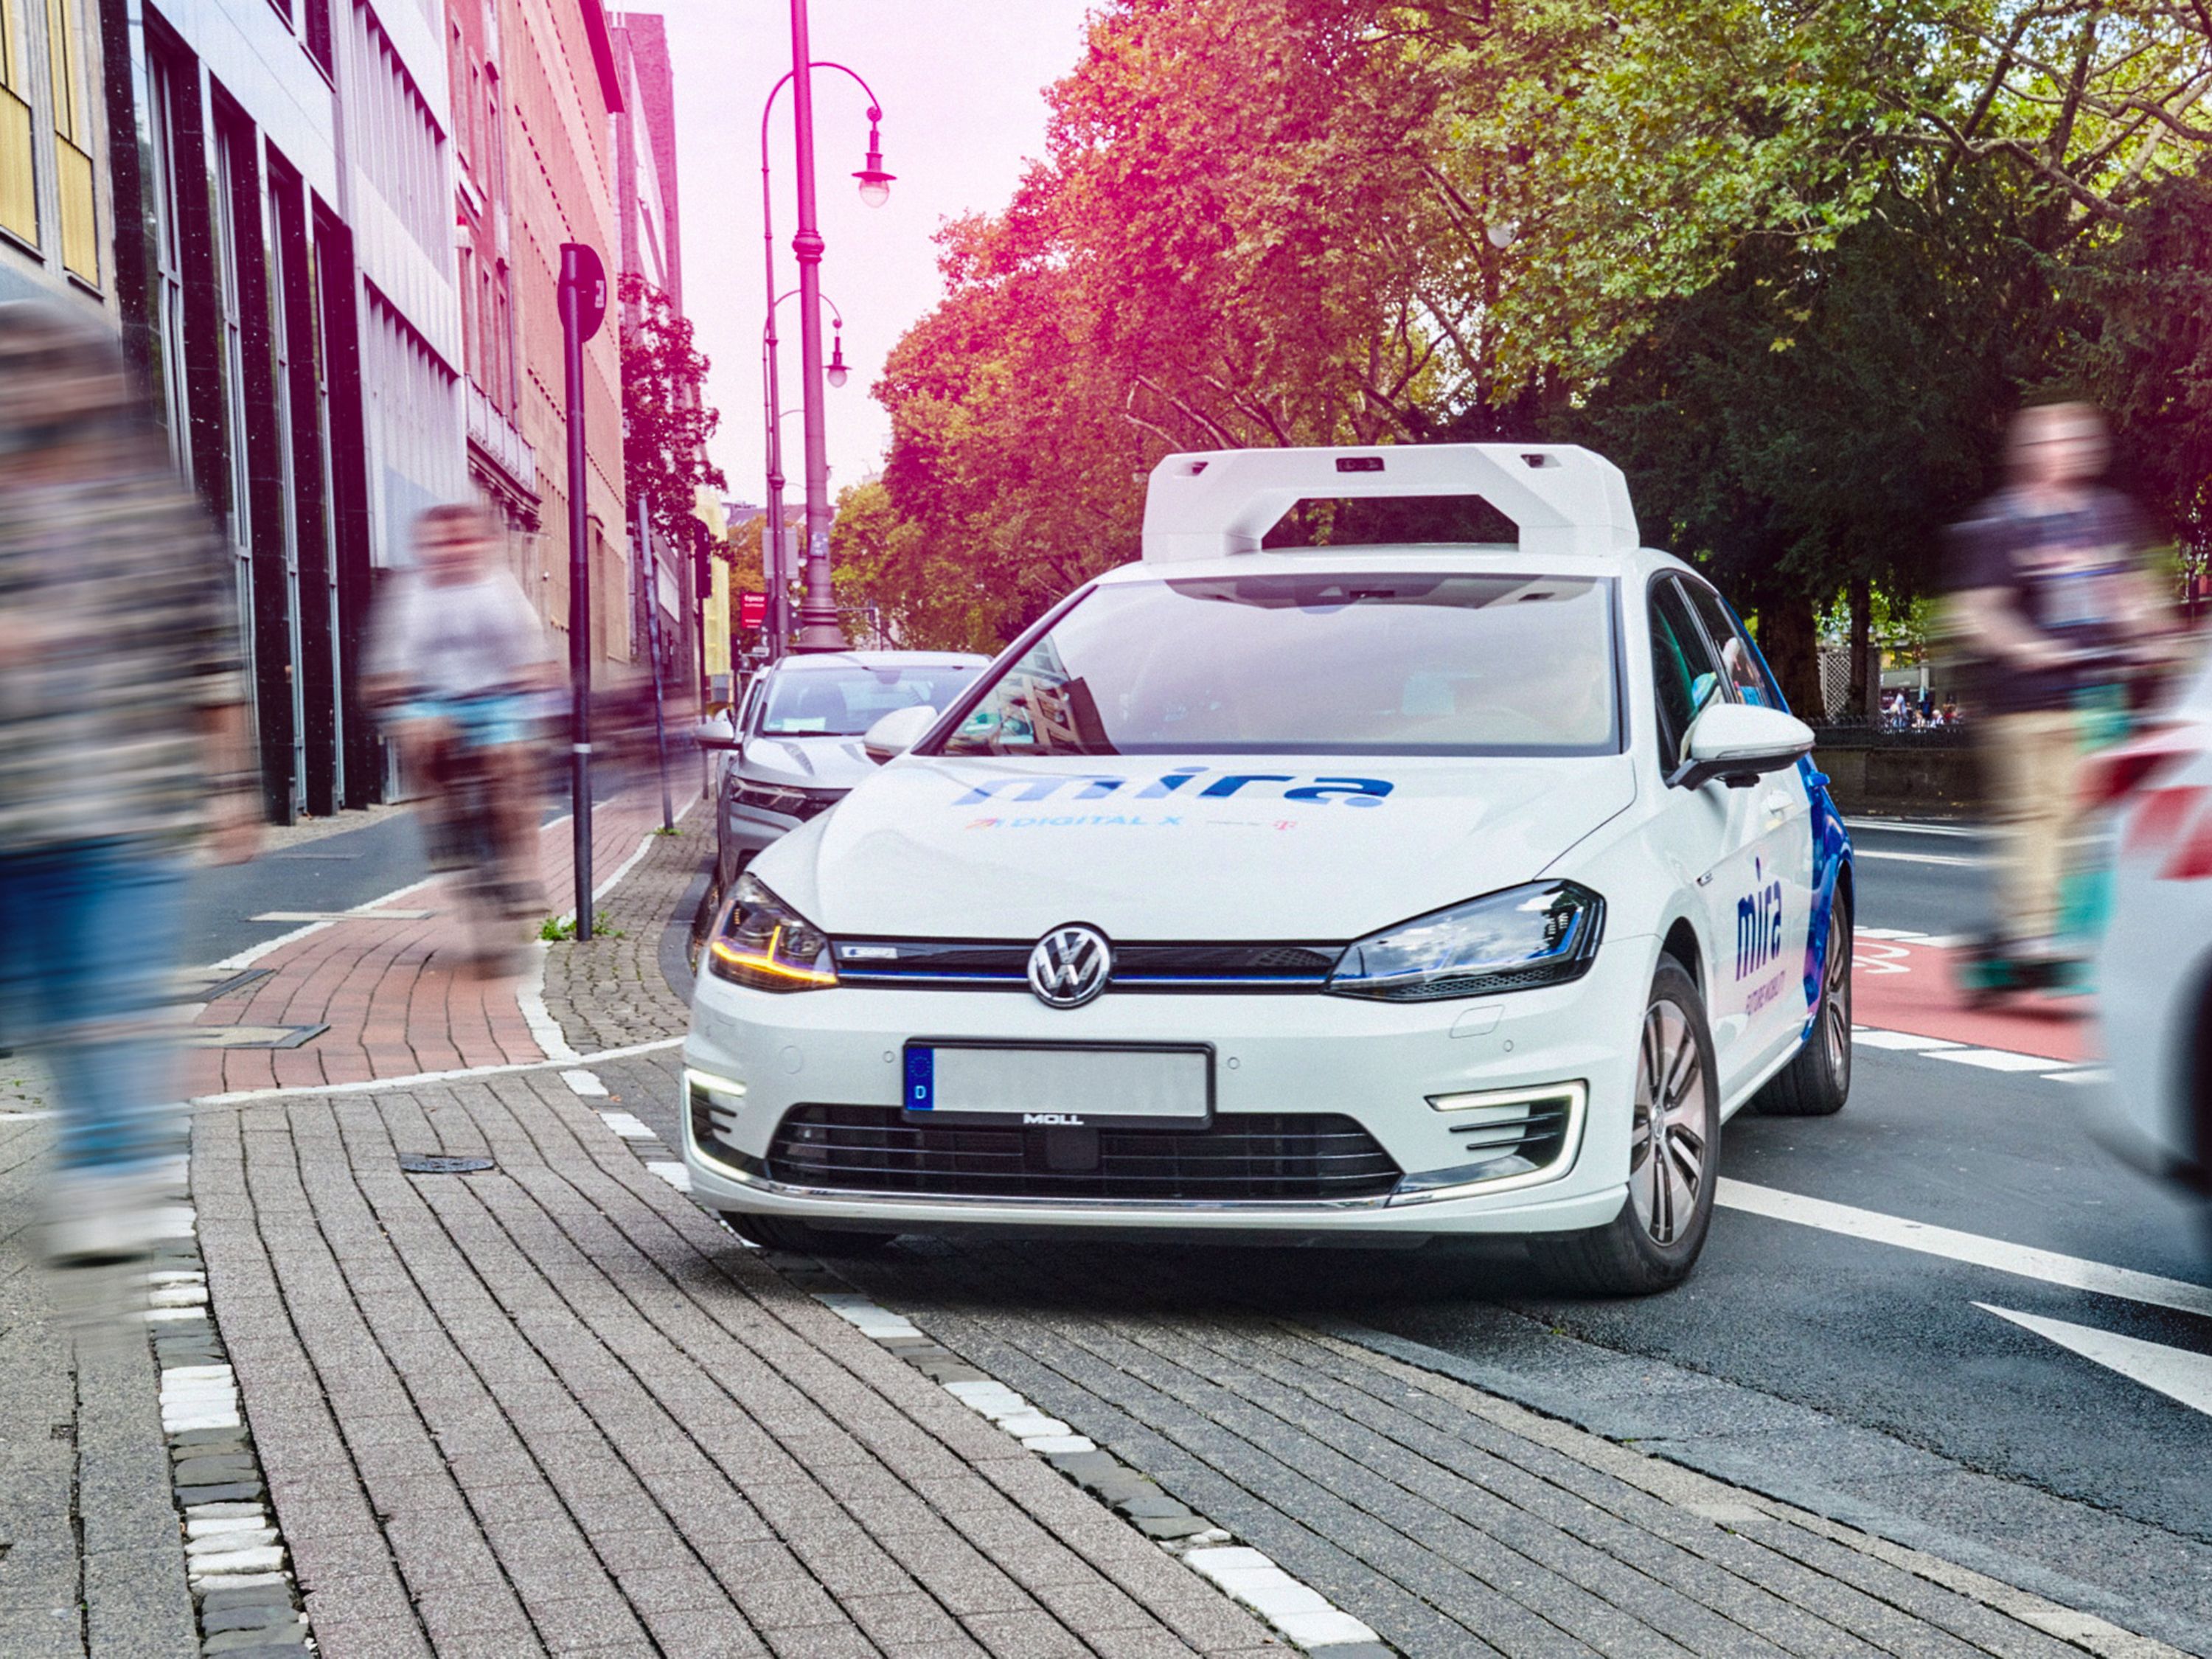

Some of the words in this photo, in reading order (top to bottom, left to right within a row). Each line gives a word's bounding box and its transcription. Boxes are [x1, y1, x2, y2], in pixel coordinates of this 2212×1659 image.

[950, 766, 1395, 807] mira
[1011, 816, 1147, 827] DIGITAL
[1158, 816, 1182, 826] X
[1736, 856, 1782, 982] mira
[914, 1085, 926, 1099] D
[1023, 1113, 1085, 1125] MOLL
